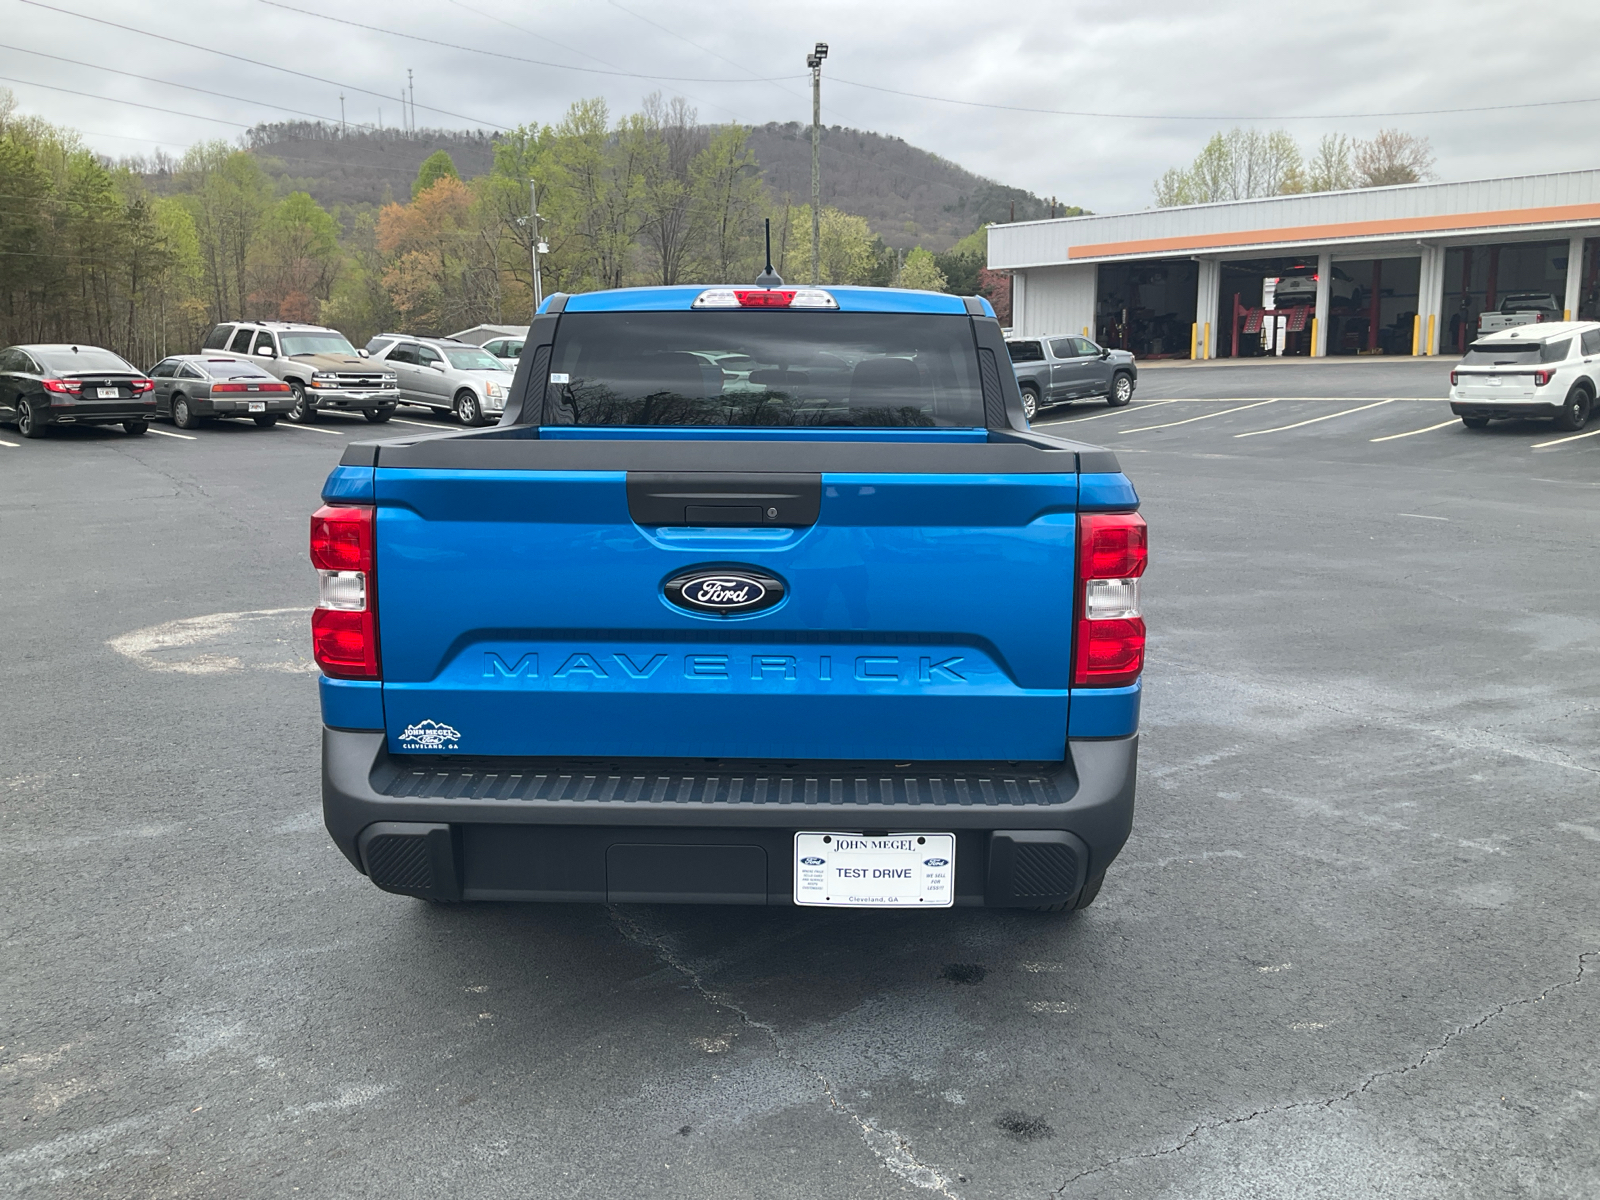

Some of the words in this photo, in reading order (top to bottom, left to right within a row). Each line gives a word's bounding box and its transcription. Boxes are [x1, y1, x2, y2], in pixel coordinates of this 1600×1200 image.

[698, 580, 749, 602] Ford
[483, 651, 968, 683] MAVERICK
[405, 729, 425, 737] JOHN
[425, 729, 453, 737] MEGEL
[833, 839, 868, 852] JOHN
[871, 839, 916, 852] MEGEL
[835, 868, 869, 879] TEST
[872, 868, 912, 879] DRIVE
